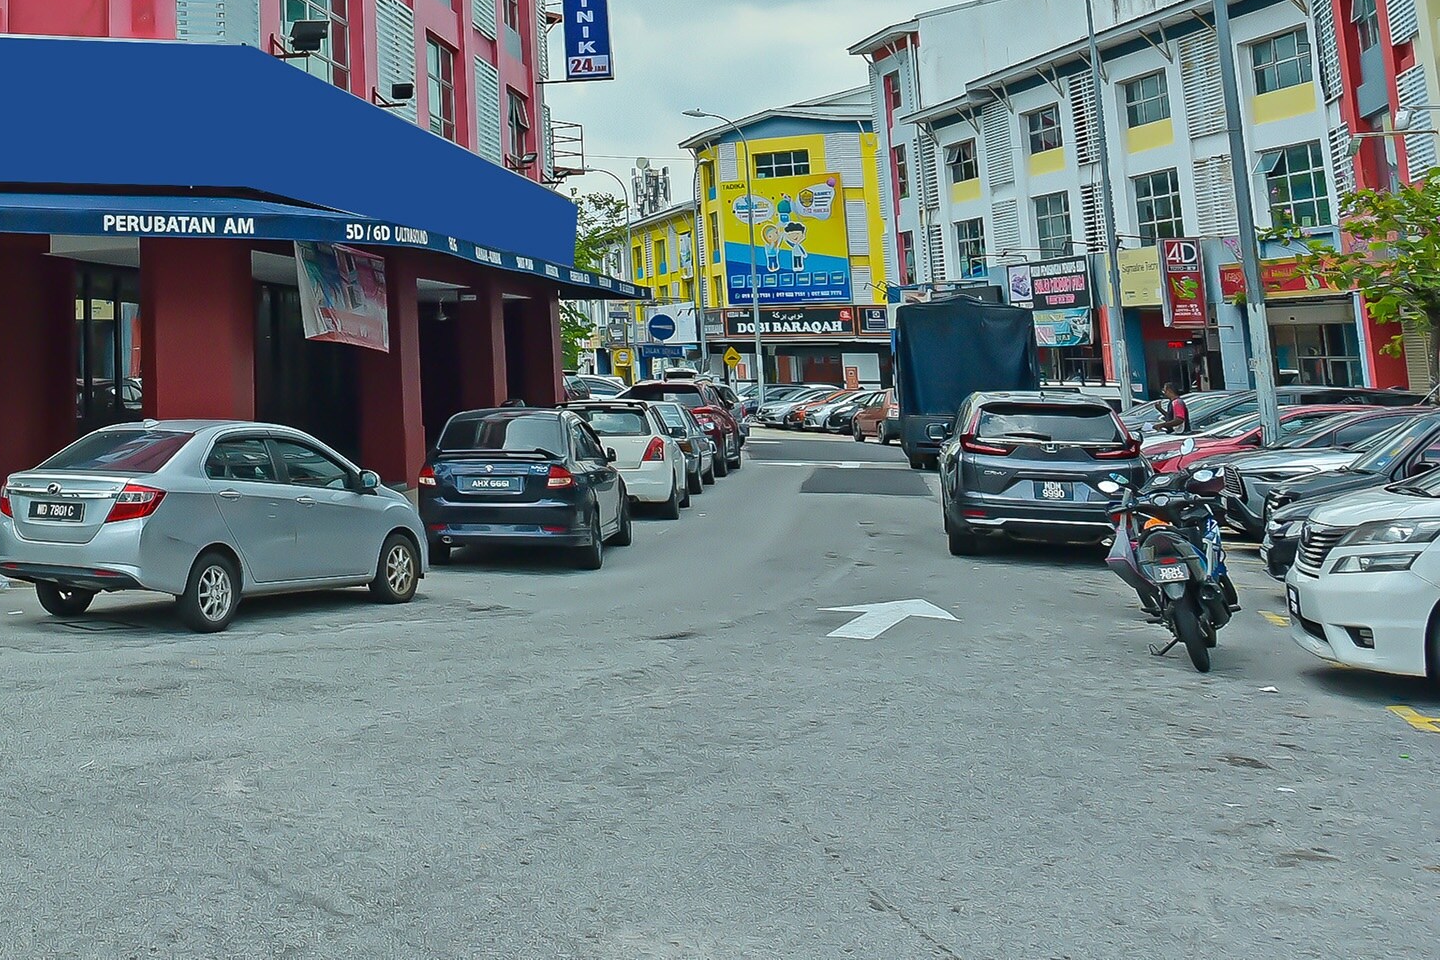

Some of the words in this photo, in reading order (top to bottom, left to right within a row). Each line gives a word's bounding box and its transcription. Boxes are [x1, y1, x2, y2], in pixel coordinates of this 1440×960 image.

[571, 58, 594, 74] 24
[722, 183, 746, 191] TADIKA
[103, 214, 216, 234] PERUBATAN
[223, 217, 255, 235] AM
[346, 224, 364, 240] 5D
[373, 225, 391, 241] 6D
[395, 226, 429, 245] ULTRASOUND
[1167, 242, 1197, 264] 4D
[737, 322, 770, 334] DOBI
[772, 320, 843, 334] BARAQAH
[472, 480, 489, 488] AHX
[489, 480, 510, 488] 6661
[1043, 490, 1065, 499] 9990
[49, 504, 67, 517] 7801
[68, 505, 75, 517] C
